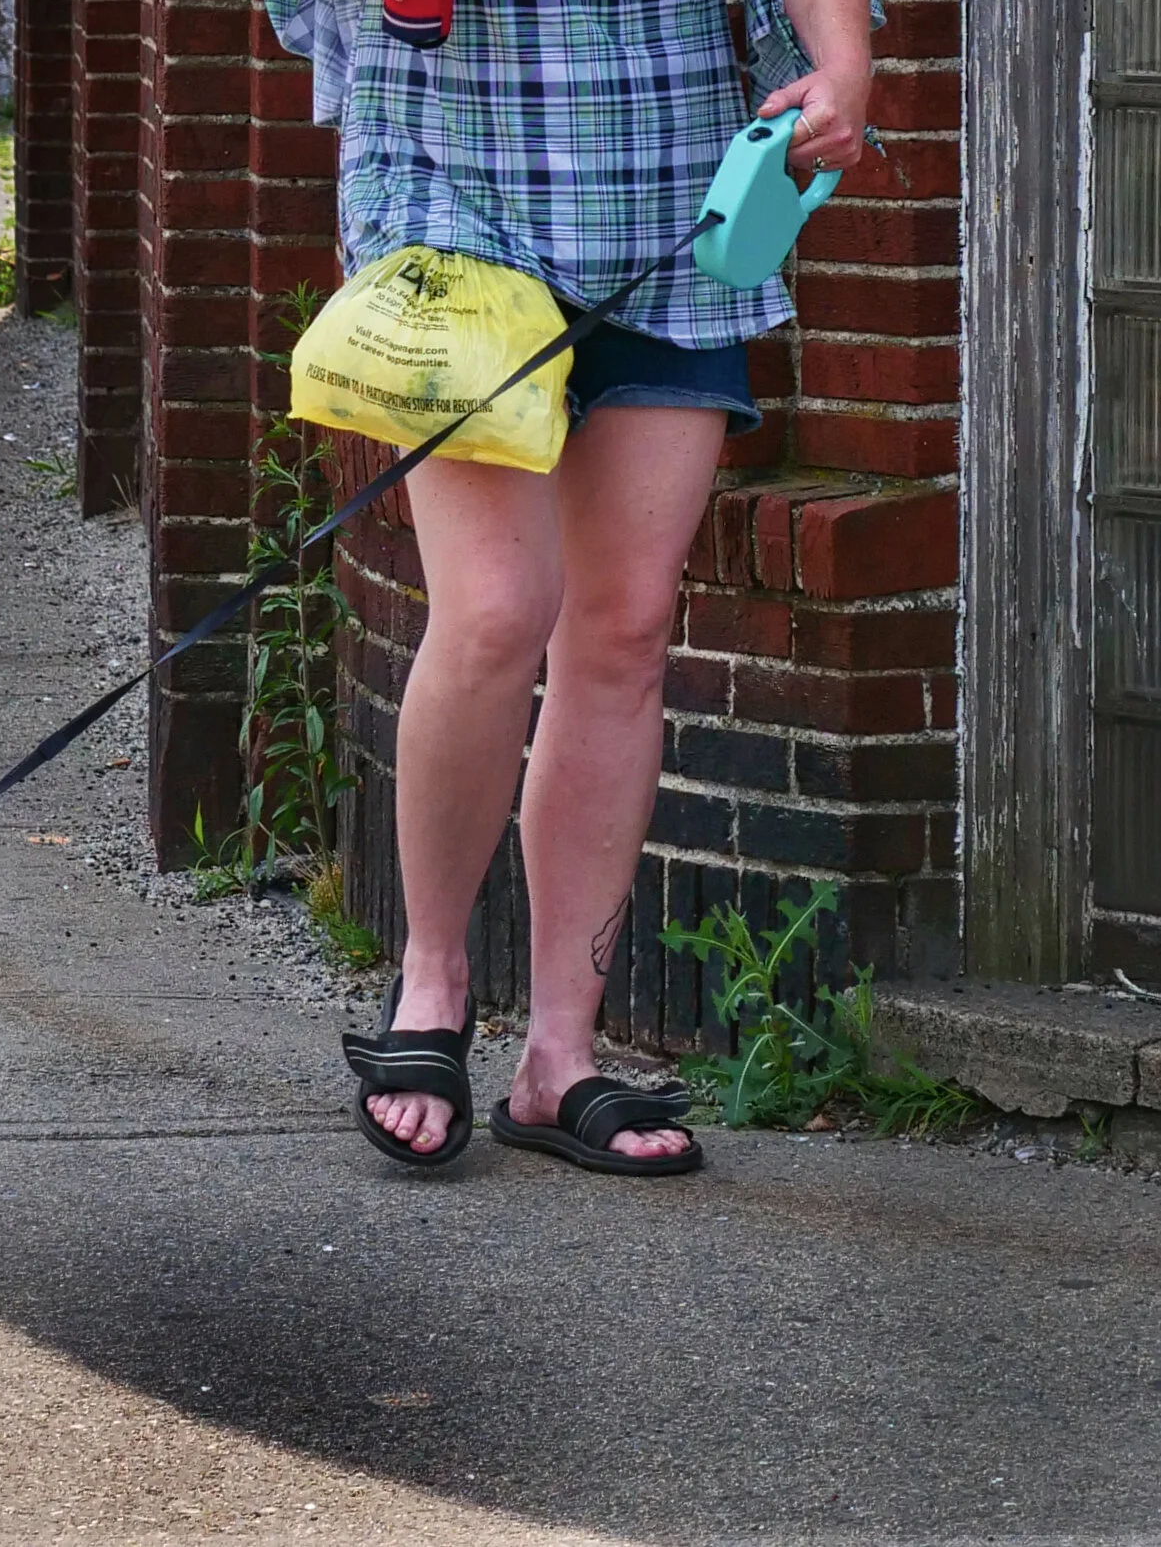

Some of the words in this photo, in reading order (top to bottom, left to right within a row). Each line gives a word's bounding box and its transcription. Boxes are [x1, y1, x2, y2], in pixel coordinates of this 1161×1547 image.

[355, 325, 372, 339] Visit
[347, 336, 360, 347] for
[306, 362, 326, 383] PLEASE
[326, 370, 351, 391] RETURN
[351, 378, 359, 394] TO
[412, 398, 435, 413] STORE
[436, 398, 451, 413] FOR
[453, 398, 493, 414] RECYCLING
